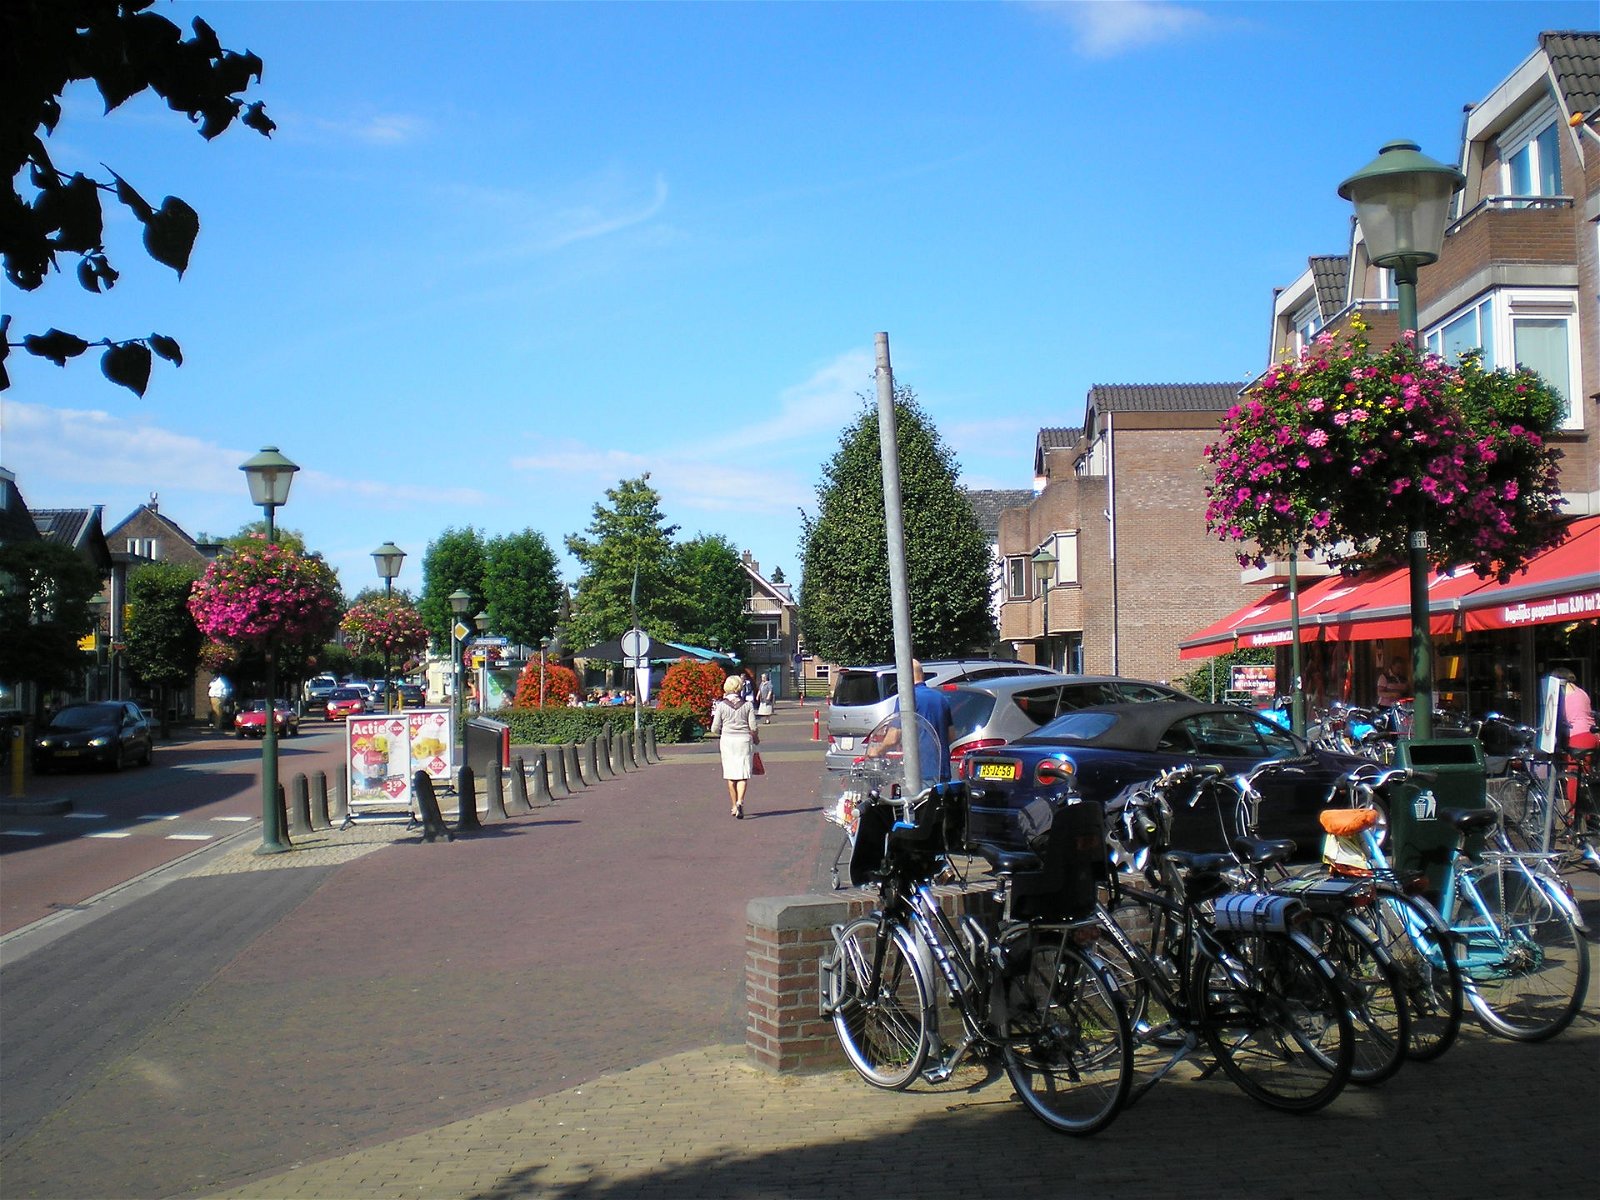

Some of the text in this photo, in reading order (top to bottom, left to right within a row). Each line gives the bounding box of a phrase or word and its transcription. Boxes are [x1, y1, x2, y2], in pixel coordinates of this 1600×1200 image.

[1505, 603, 1530, 624] Dagelijks
[1531, 599, 1556, 622] geopend
[1557, 602, 1569, 614] van
[1570, 596, 1584, 612] 8.00
[1585, 595, 1594, 610] tot
[352, 720, 386, 734] Actie
[1096, 912, 1138, 959] GAZELLE
